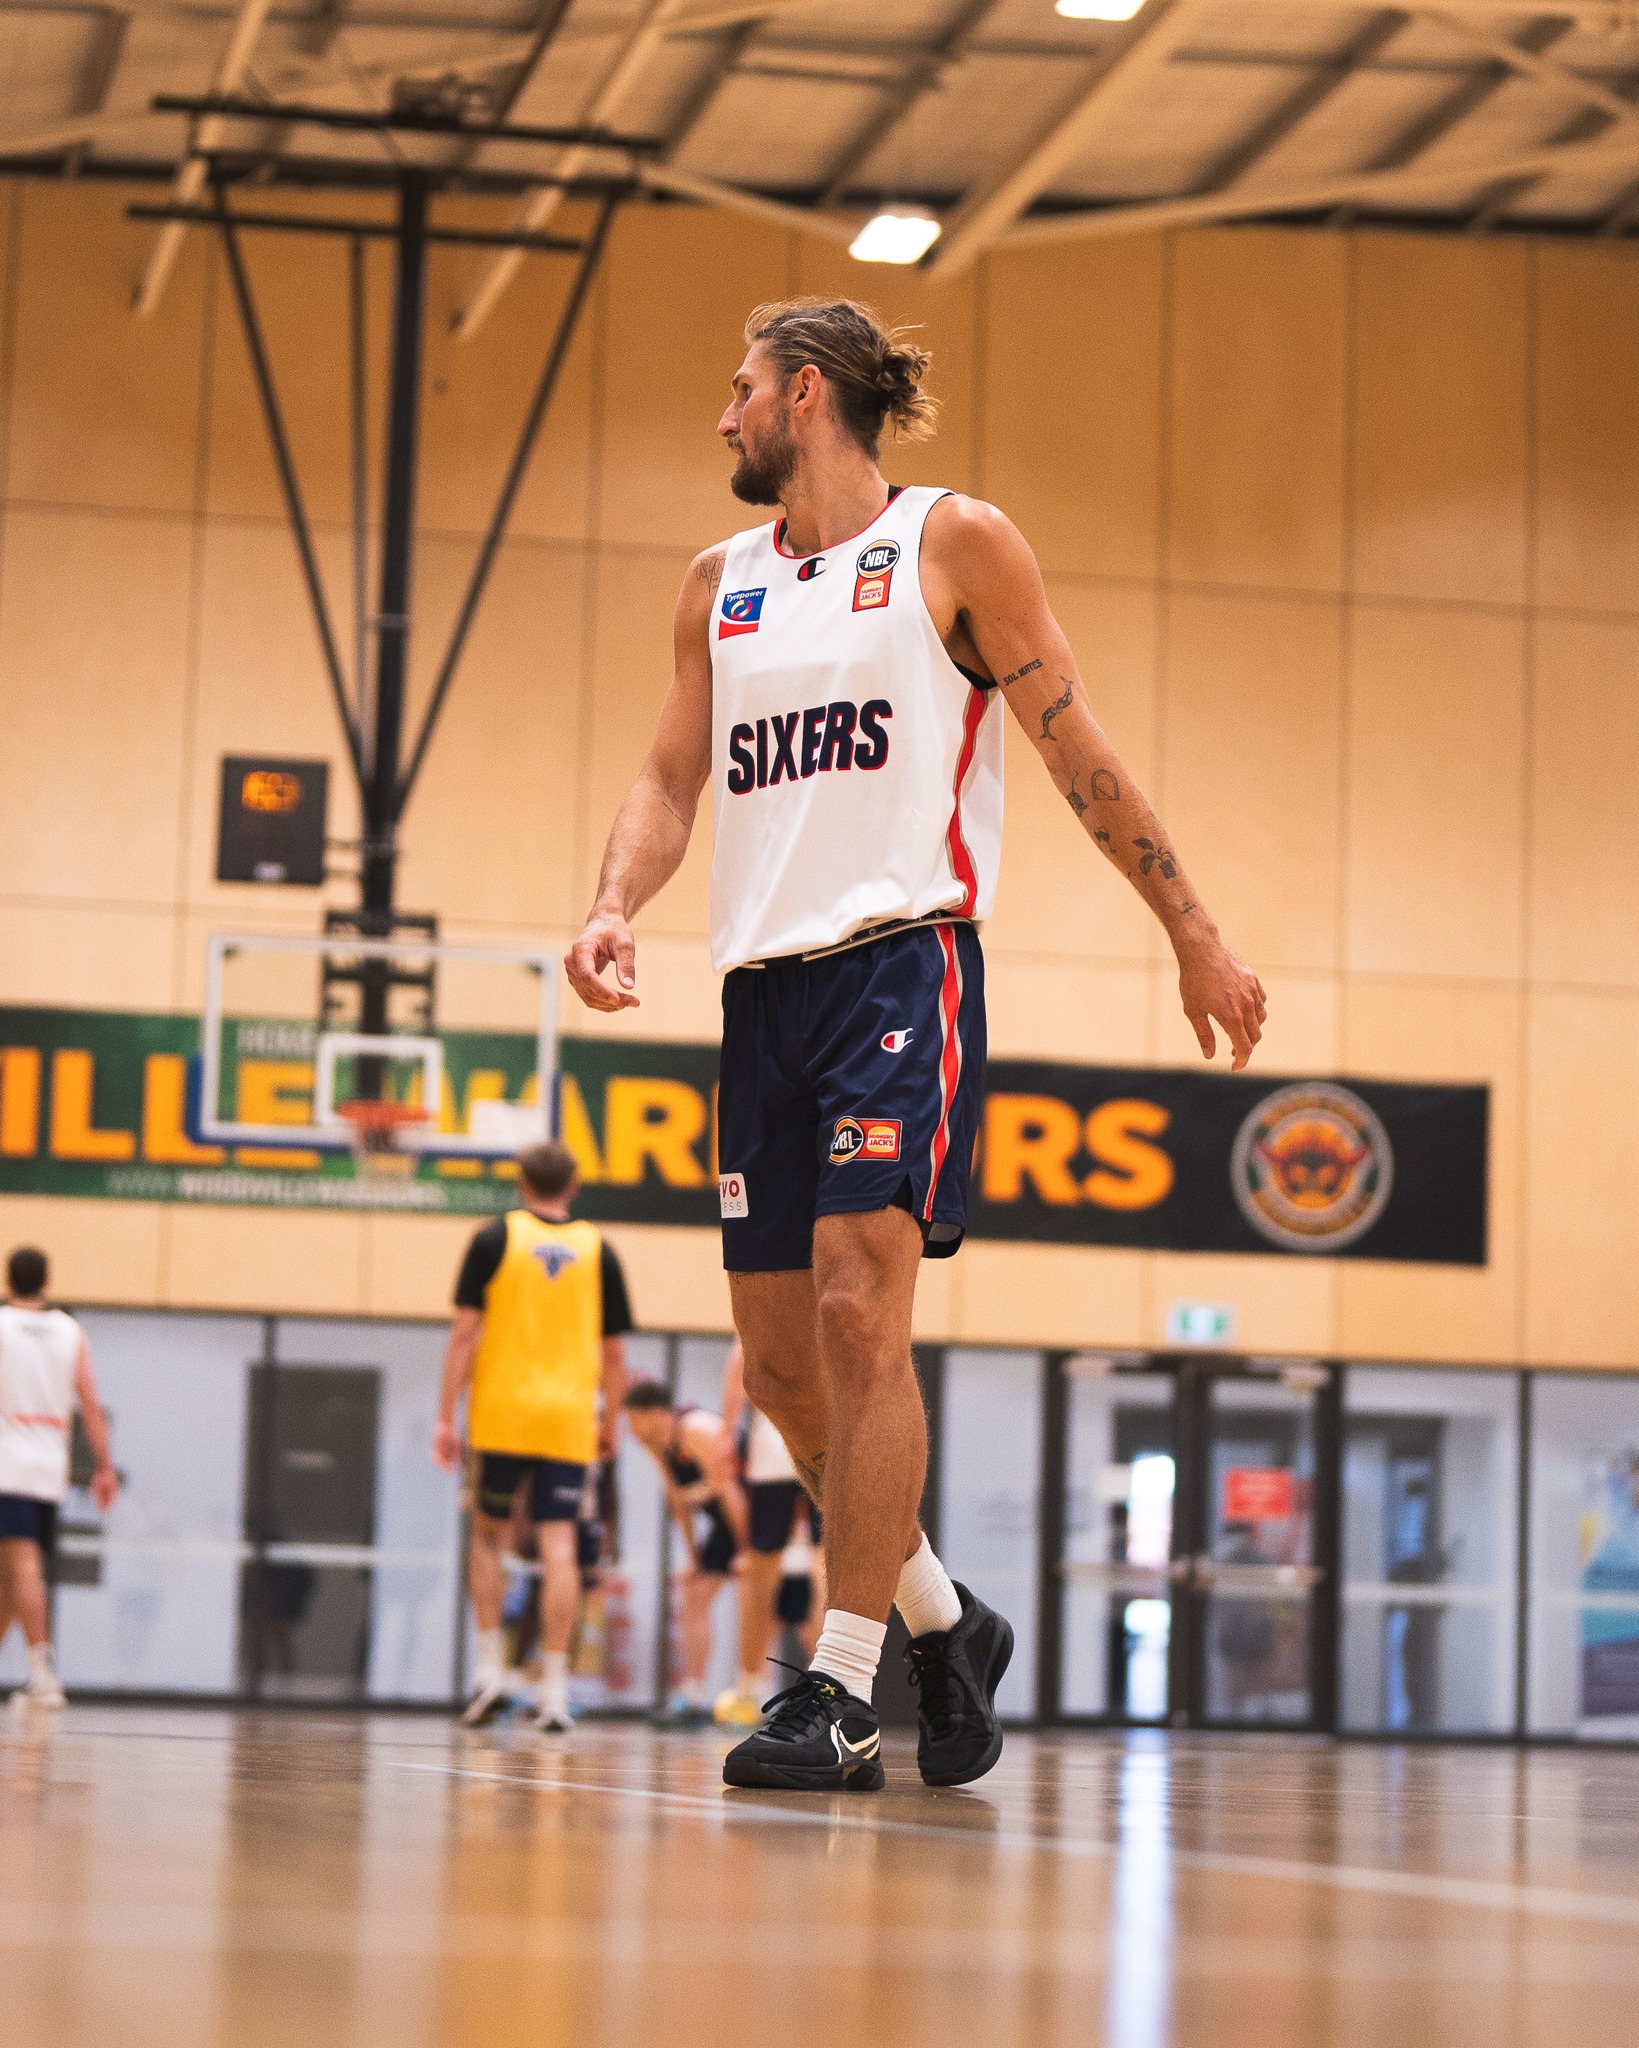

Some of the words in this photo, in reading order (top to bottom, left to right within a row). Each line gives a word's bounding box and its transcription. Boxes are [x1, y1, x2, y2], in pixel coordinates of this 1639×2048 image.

[864, 549, 889, 568] NBL
[726, 590, 764, 603] Tyrepower
[728, 698, 893, 796] SIXERS
